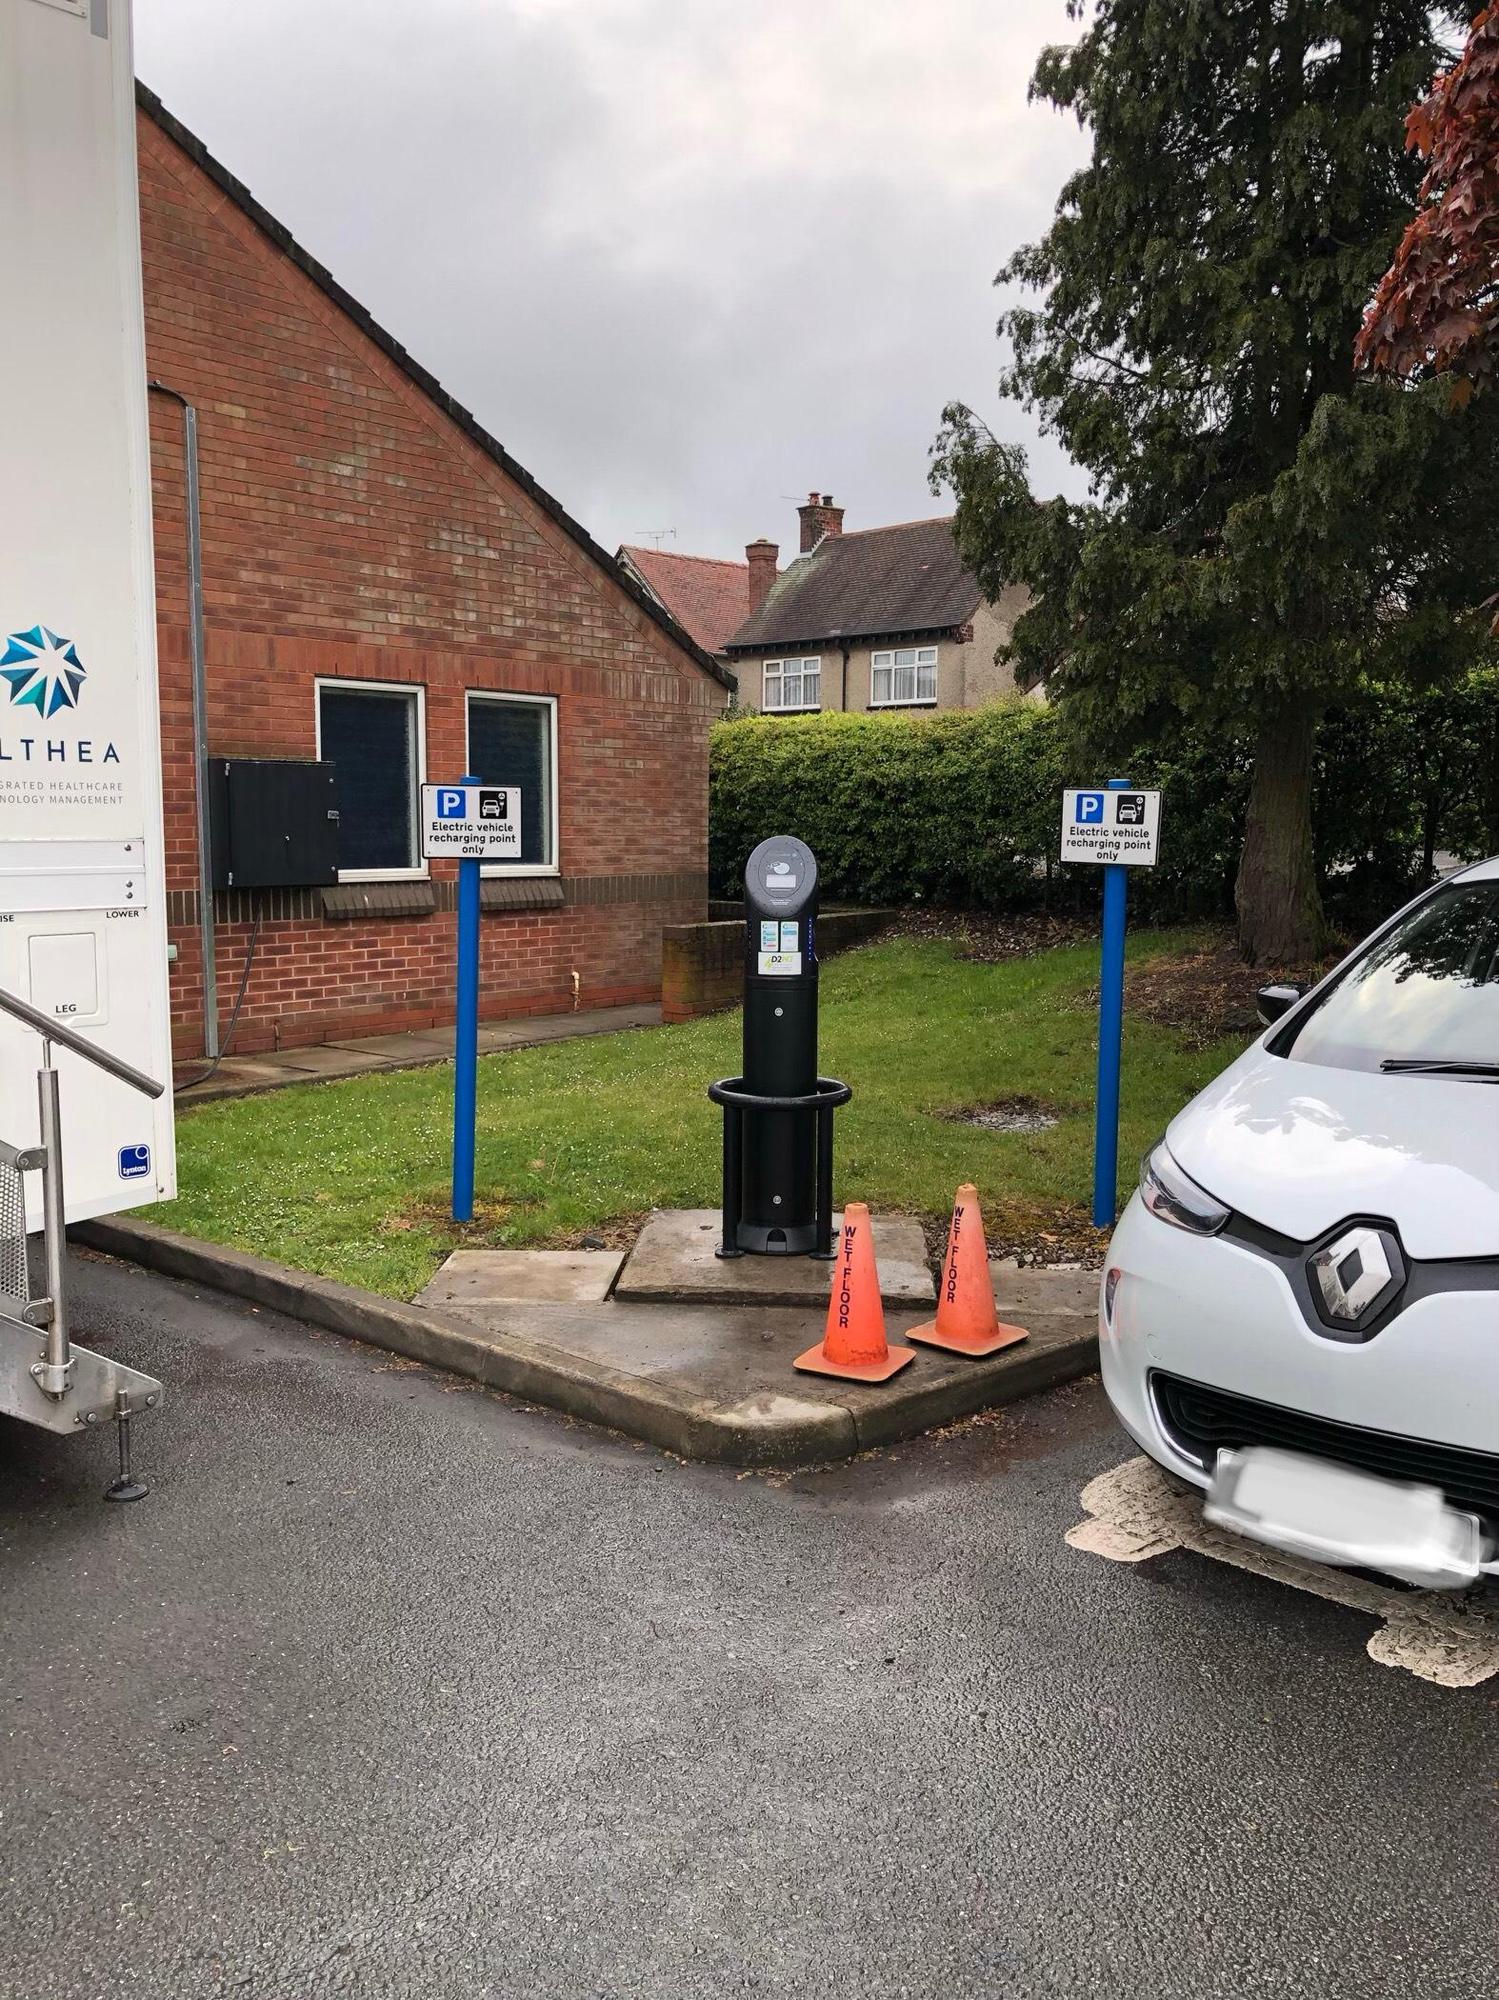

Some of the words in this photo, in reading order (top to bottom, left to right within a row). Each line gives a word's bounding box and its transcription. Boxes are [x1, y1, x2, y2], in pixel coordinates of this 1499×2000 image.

[0, 738, 120, 763] LTHEA
[49, 782, 123, 791] HEALTHCARE
[49, 795, 124, 805] MANAGEMENT
[443, 792, 461, 816] P
[1081, 797, 1099, 820] P
[432, 822, 473, 832] Electric
[476, 823, 514, 832] vehicle
[1069, 826, 1109, 837] Electric
[1112, 828, 1150, 838] vehicle
[429, 833, 486, 844] recharging
[489, 834, 516, 844] point
[1066, 838, 1121, 850] recharging
[1124, 839, 1151, 850] point
[462, 845, 485, 855] only
[1096, 850, 1119, 862] only
[105, 910, 140, 919] LOWER
[55, 1004, 77, 1014] LEG
[122, 1165, 147, 1176] Lynton
[953, 1205, 965, 1241] WET
[844, 1225, 857, 1263] WET
[946, 1245, 960, 1304] FLOOR
[839, 1267, 852, 1329] FLOOR
